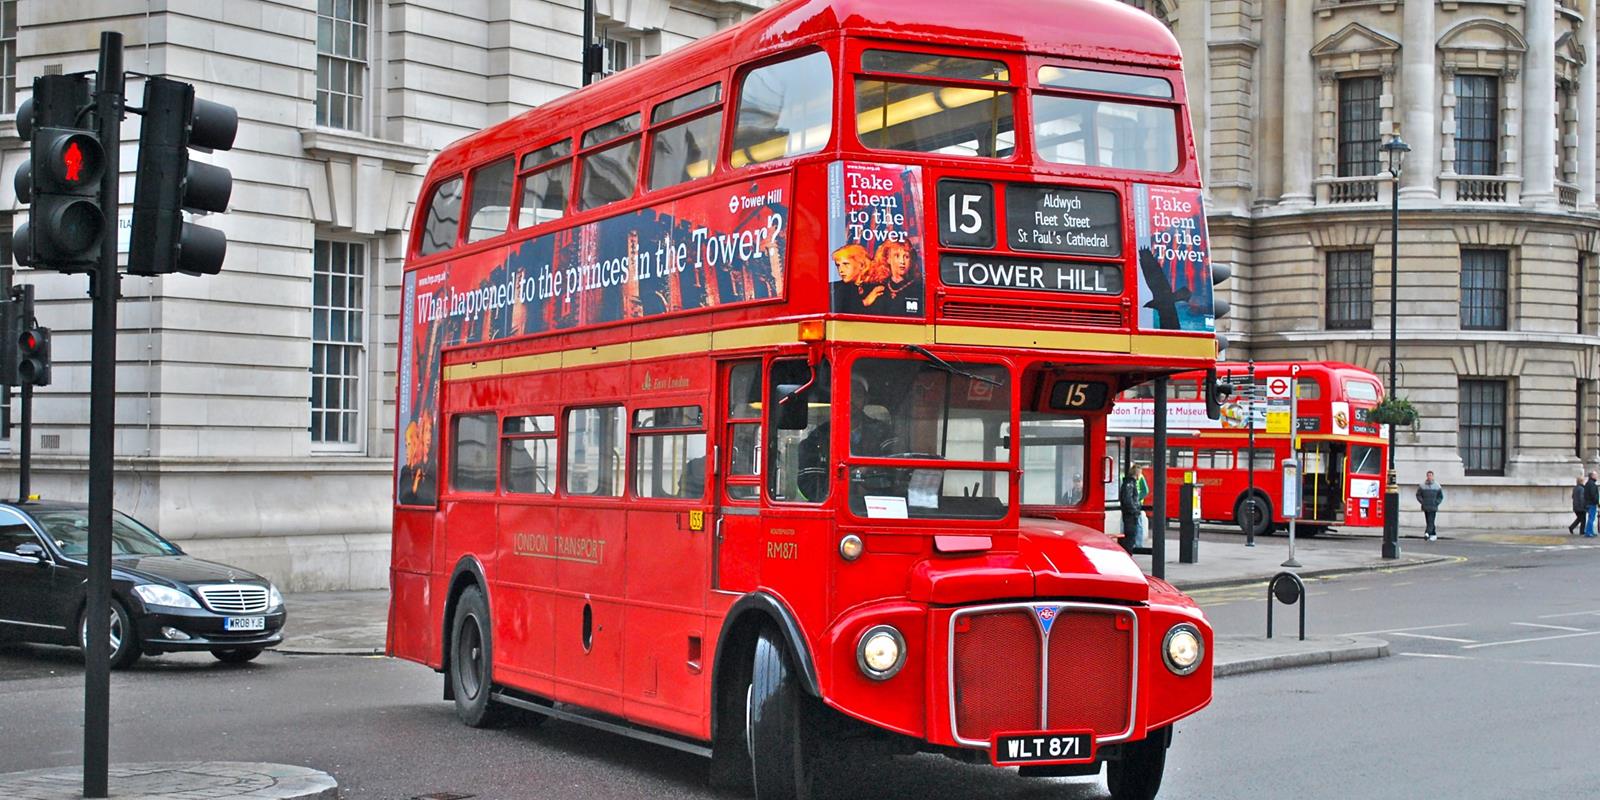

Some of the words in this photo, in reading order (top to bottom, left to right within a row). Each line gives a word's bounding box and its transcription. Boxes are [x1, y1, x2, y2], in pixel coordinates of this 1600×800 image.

[847, 172, 893, 190] Take
[741, 194, 765, 209] Tower
[768, 189, 783, 204] Hill
[848, 190, 897, 208] them
[1043, 193, 1081, 212] Aldwych
[1152, 195, 1191, 213] Take
[849, 207, 869, 223] to
[873, 208, 904, 225] the
[948, 193, 982, 234] 15
[1035, 211, 1058, 227] Fleet
[1063, 213, 1091, 229] Street
[1153, 212, 1195, 229] them
[849, 224, 908, 243] Tower
[1018, 228, 1028, 243] St
[1033, 229, 1061, 245] Paul's
[1066, 232, 1109, 248] Cathedral
[1154, 229, 1171, 244] to
[1175, 229, 1201, 246] the
[1154, 244, 1205, 263] Tower
[418, 292, 449, 325] What
[450, 272, 515, 322] happened
[518, 270, 535, 304] to
[538, 264, 562, 300] the
[565, 255, 629, 303] princes
[634, 243, 651, 280] in
[655, 232, 687, 278] the
[692, 212, 783, 268] Tower?
[953, 262, 1045, 288] TOWER
[1057, 267, 1107, 292] HILL
[1292, 365, 1300, 376] P
[1065, 383, 1089, 407] 15
[513, 533, 549, 555] LONDON
[554, 535, 605, 565] TRANSPORT
[767, 541, 798, 560] RM871
[230, 618, 250, 628] WR08
[1040, 609, 1055, 619] AEC
[1007, 738, 1045, 758] WLT
[1048, 737, 1080, 757] 871
